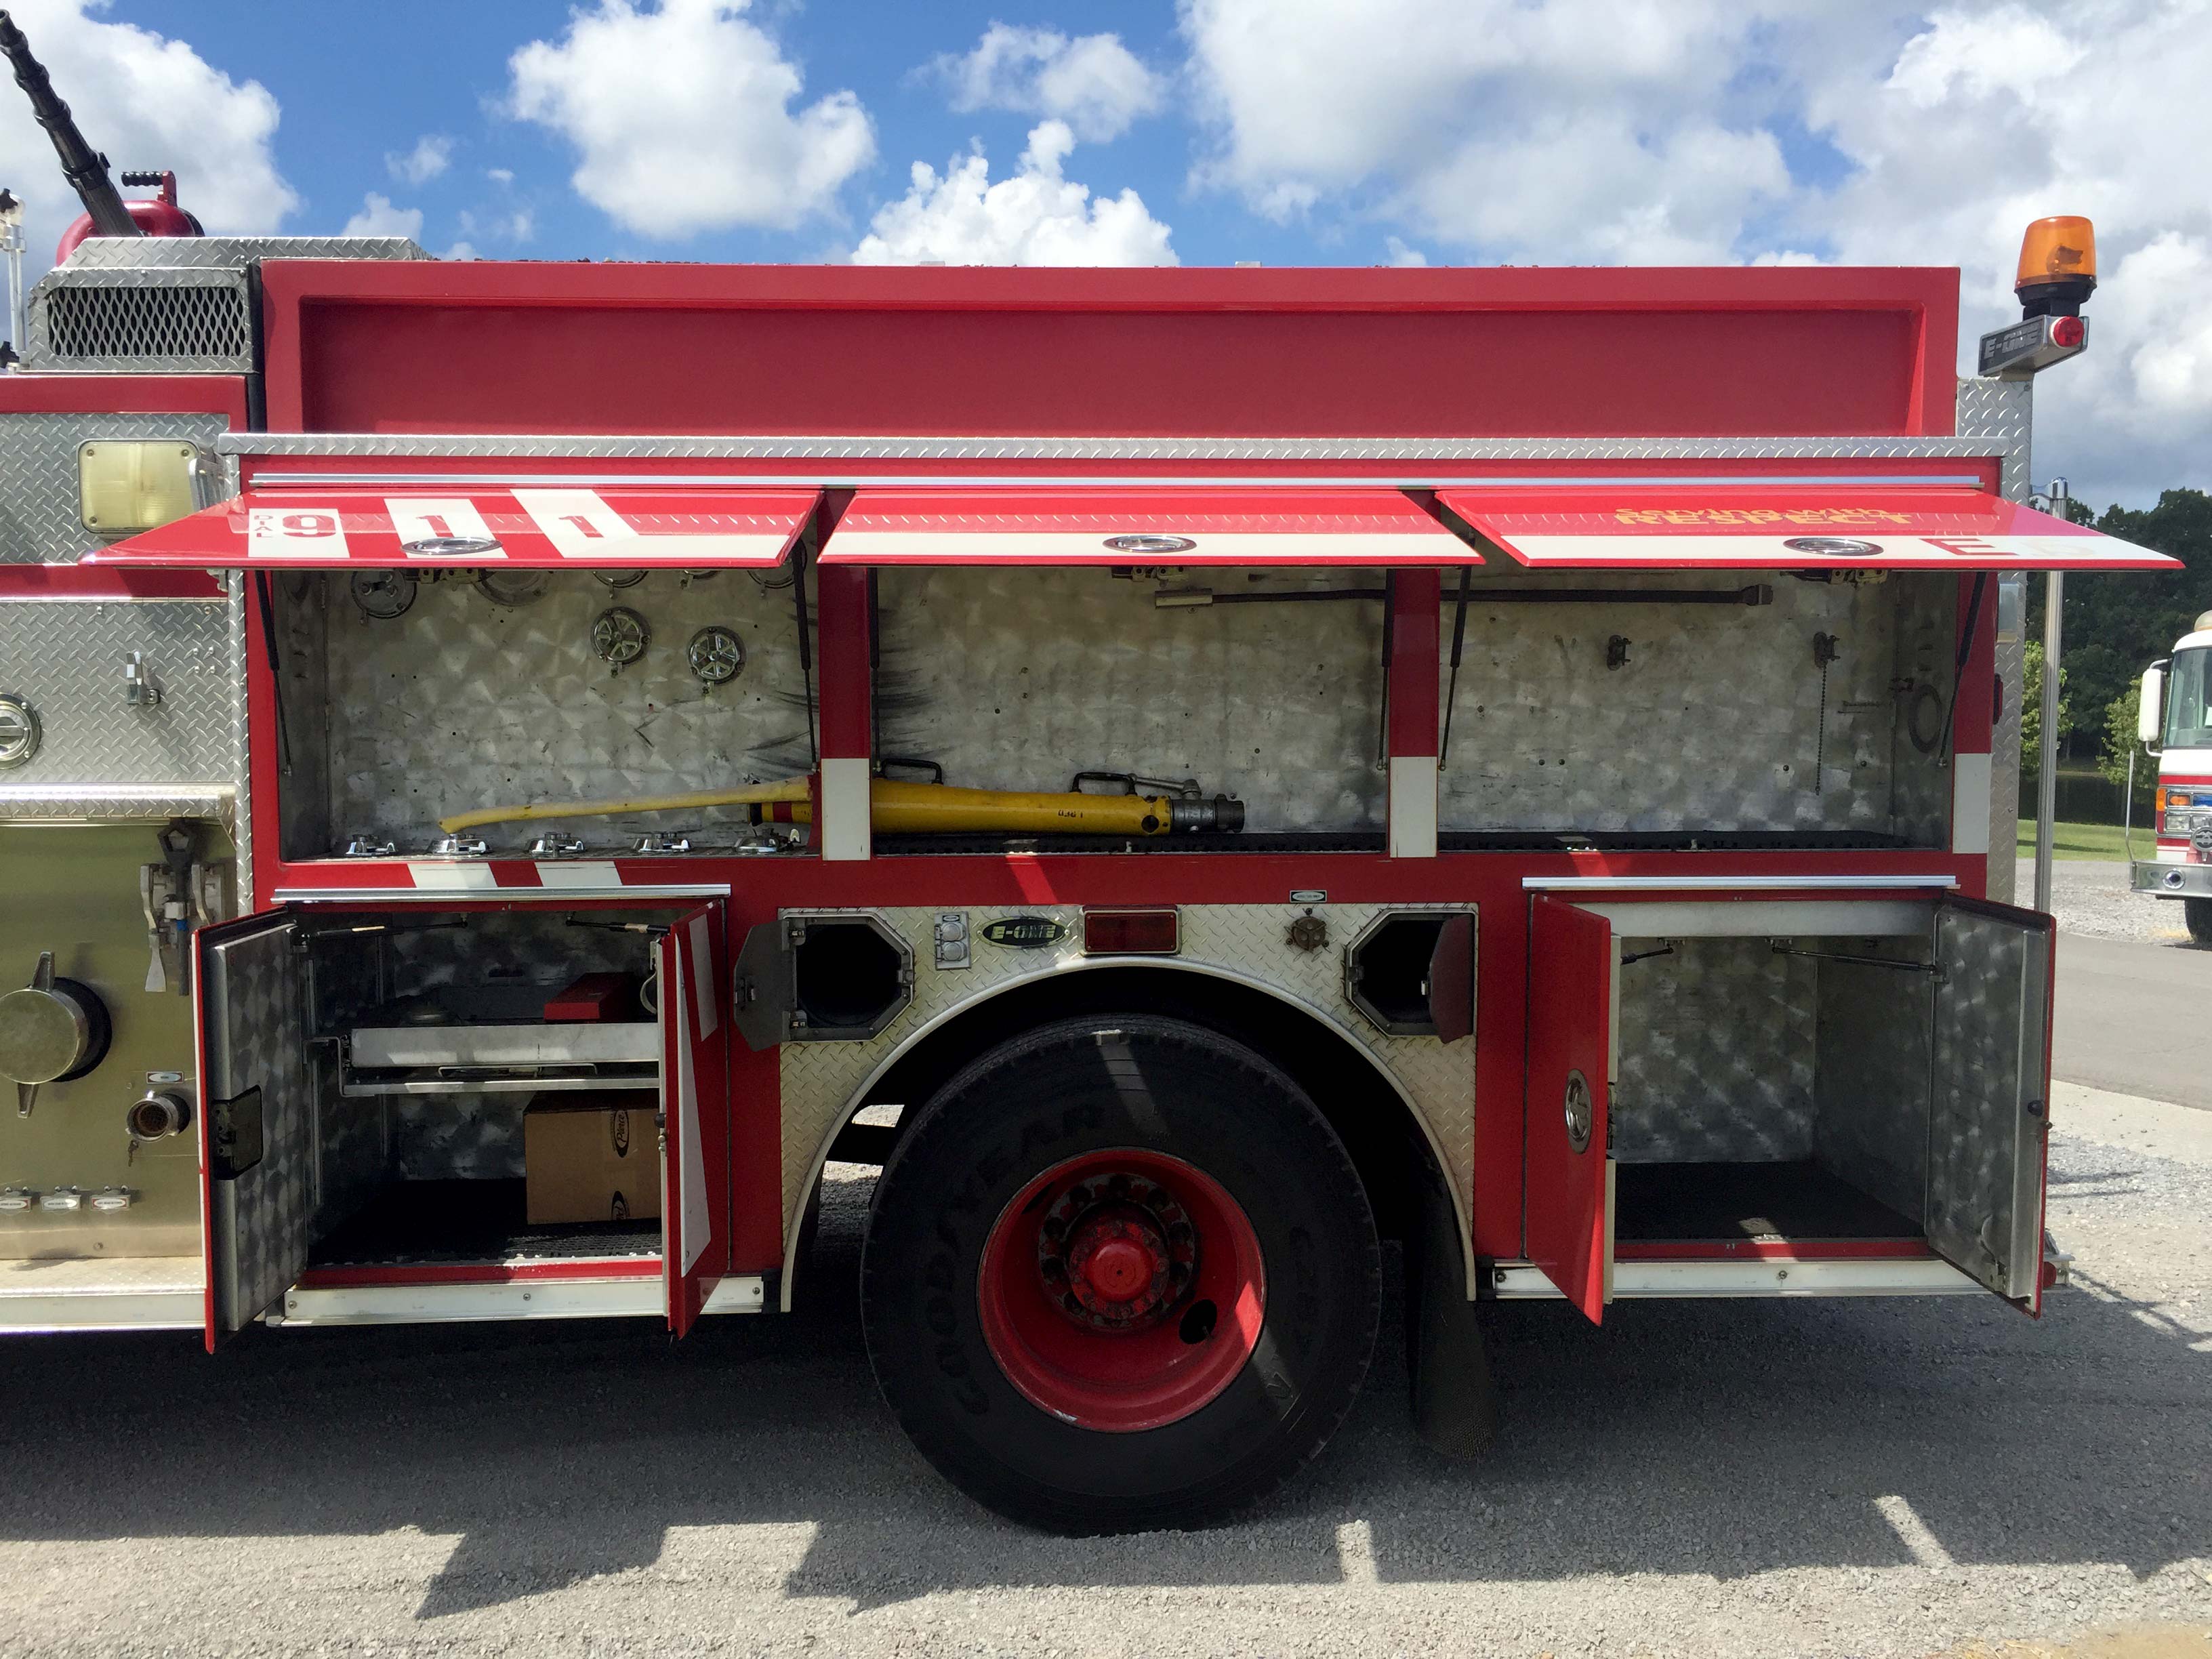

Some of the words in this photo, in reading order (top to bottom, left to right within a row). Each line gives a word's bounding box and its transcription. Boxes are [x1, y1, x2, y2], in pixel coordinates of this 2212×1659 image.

[1984, 324, 2039, 359] E-ONE
[1614, 514, 1912, 525] RESPECT
[1615, 508, 1780, 517] Serving
[253, 514, 274, 538] DIAL
[990, 924, 1057, 940] E-ONE
